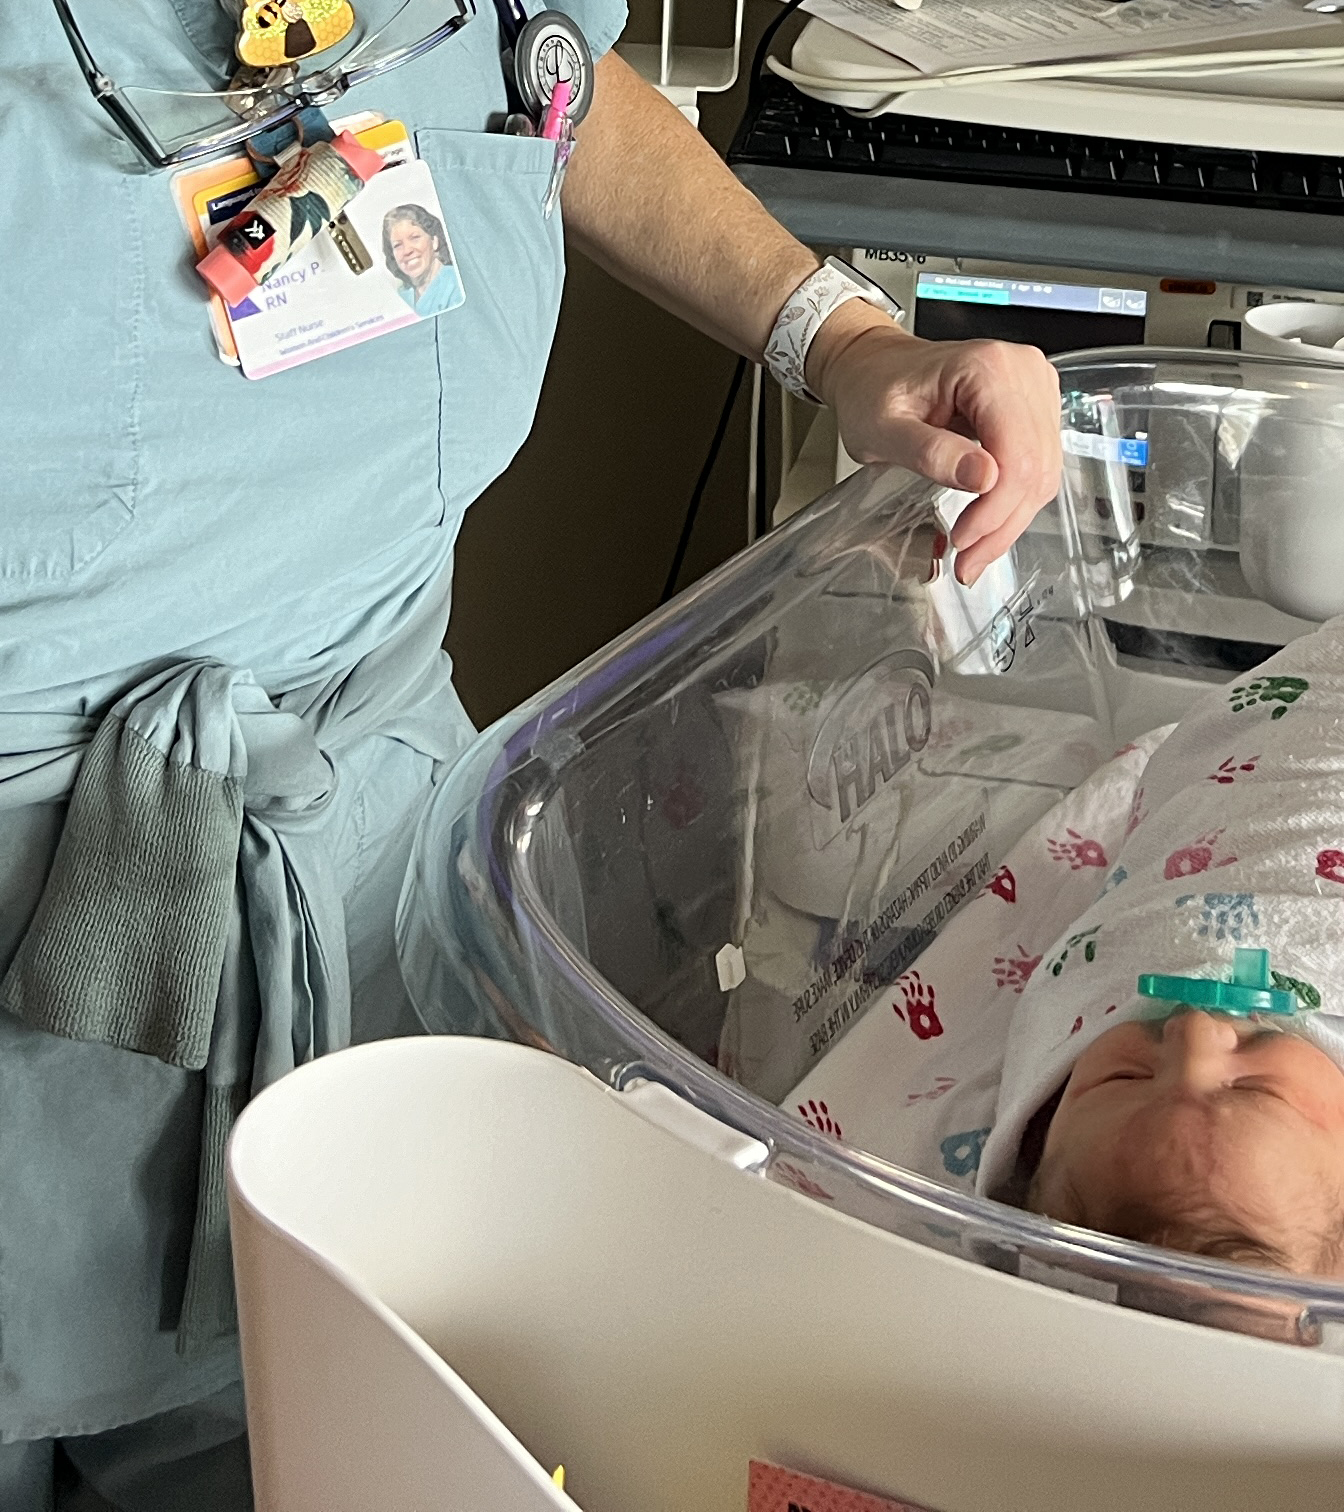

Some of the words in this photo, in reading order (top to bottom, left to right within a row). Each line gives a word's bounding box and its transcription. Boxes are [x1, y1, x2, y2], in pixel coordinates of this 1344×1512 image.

[262, 268, 307, 293] Nancy
[265, 292, 288, 310] RN
[832, 682, 931, 823] HALO
